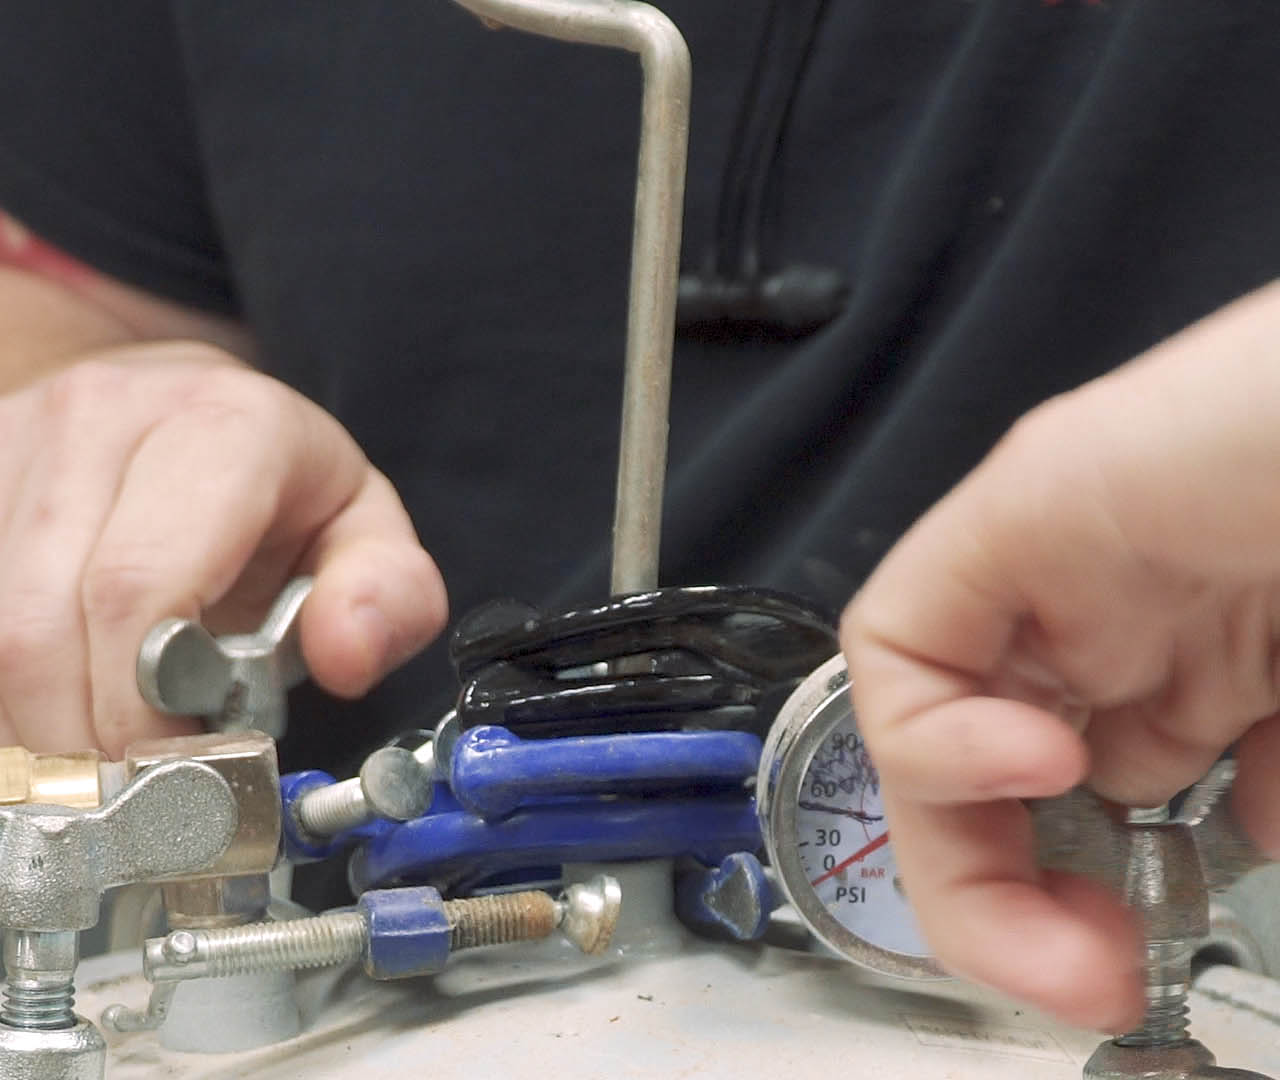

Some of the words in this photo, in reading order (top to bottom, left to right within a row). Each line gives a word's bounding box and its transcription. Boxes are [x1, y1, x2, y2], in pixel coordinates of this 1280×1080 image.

[810, 782, 837, 798] 60
[815, 829, 841, 846] 30
[860, 867, 885, 879] BAR
[836, 886, 866, 903] PSI
